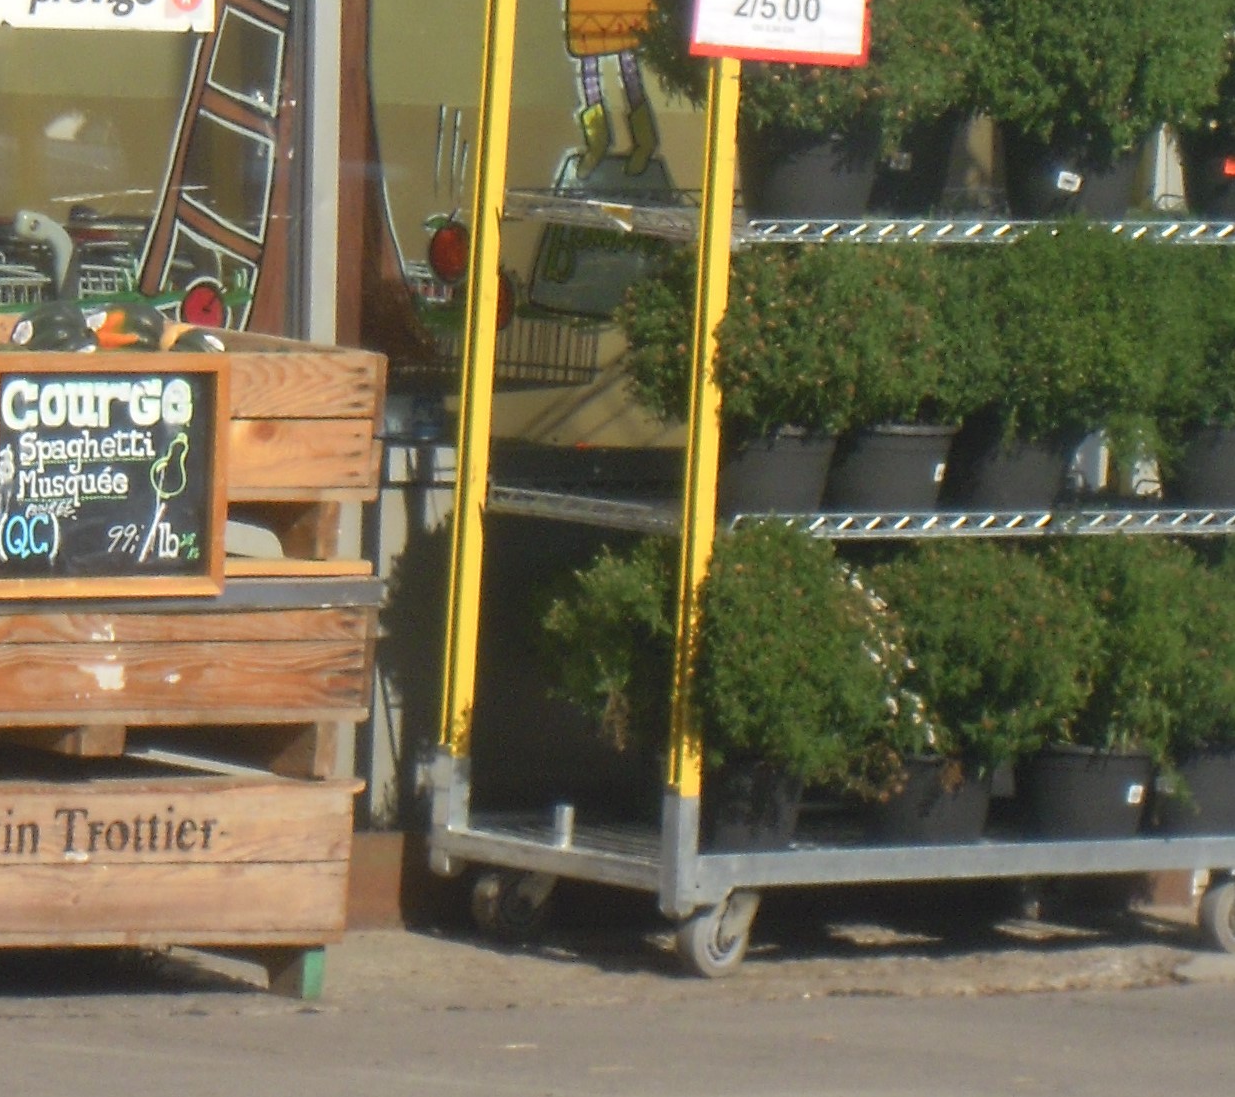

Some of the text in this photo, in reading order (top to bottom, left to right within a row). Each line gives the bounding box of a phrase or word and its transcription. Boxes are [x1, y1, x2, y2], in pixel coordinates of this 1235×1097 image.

[19, 430, 155, 474] Spaghetti
[17, 466, 129, 507] Musquée
[54, 805, 218, 854] Trottier
